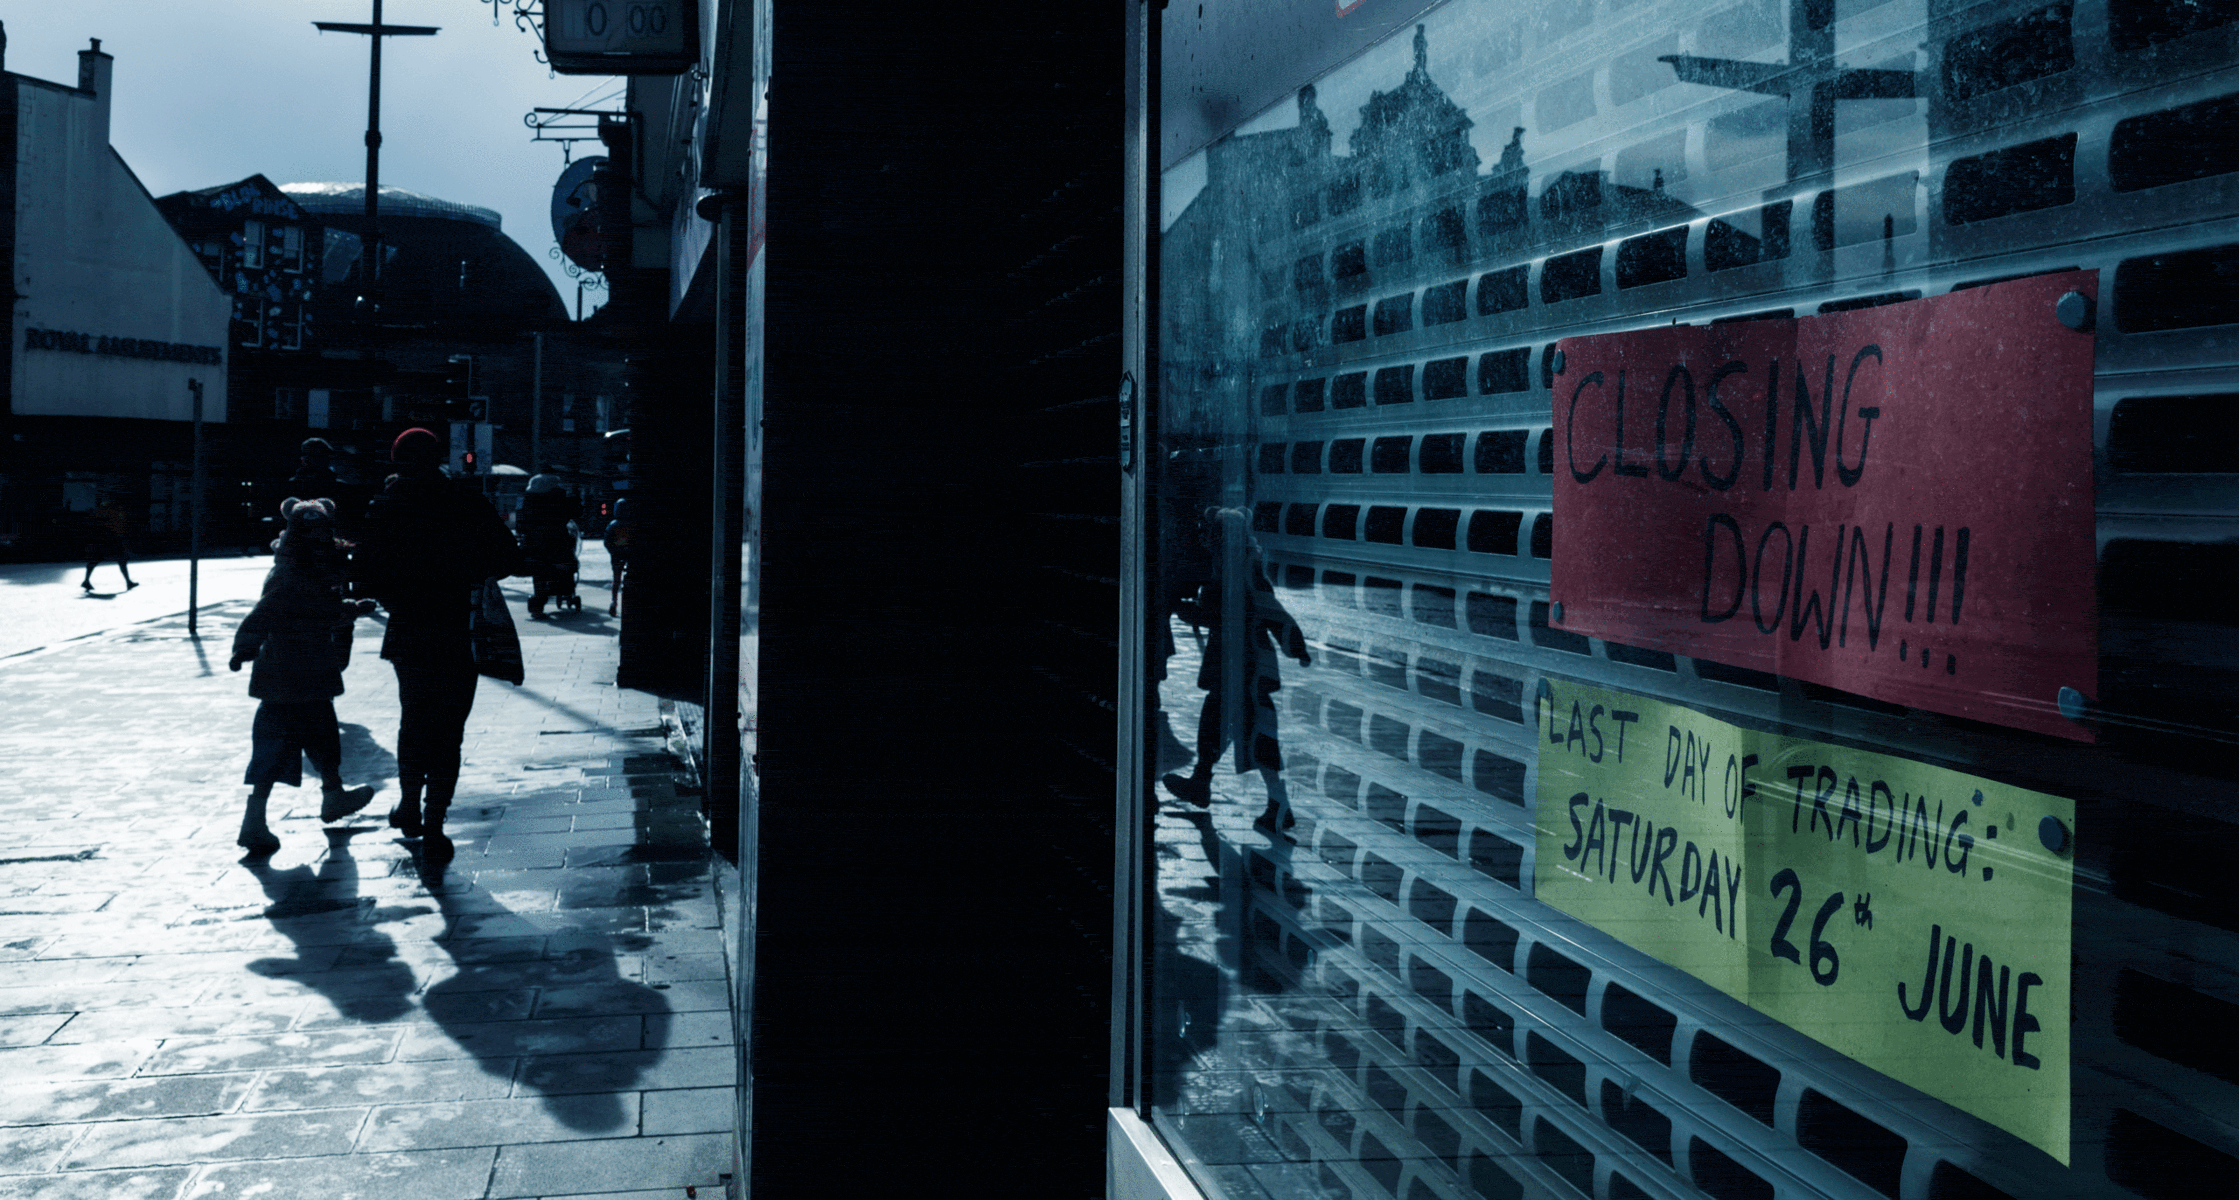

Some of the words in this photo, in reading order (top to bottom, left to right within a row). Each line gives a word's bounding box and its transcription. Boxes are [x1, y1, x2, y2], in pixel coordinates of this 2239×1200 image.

[1567, 344, 1883, 491] CLOSING
[1700, 513, 1970, 675] DOWN!!!
[1546, 693, 1639, 764] LAST
[1665, 725, 1710, 806] DAY
[1725, 754, 1757, 824] OF
[1788, 765, 1997, 881] TRADING:
[1563, 792, 1741, 939] SATURDAY
[1898, 923, 2043, 1070] JUNE
